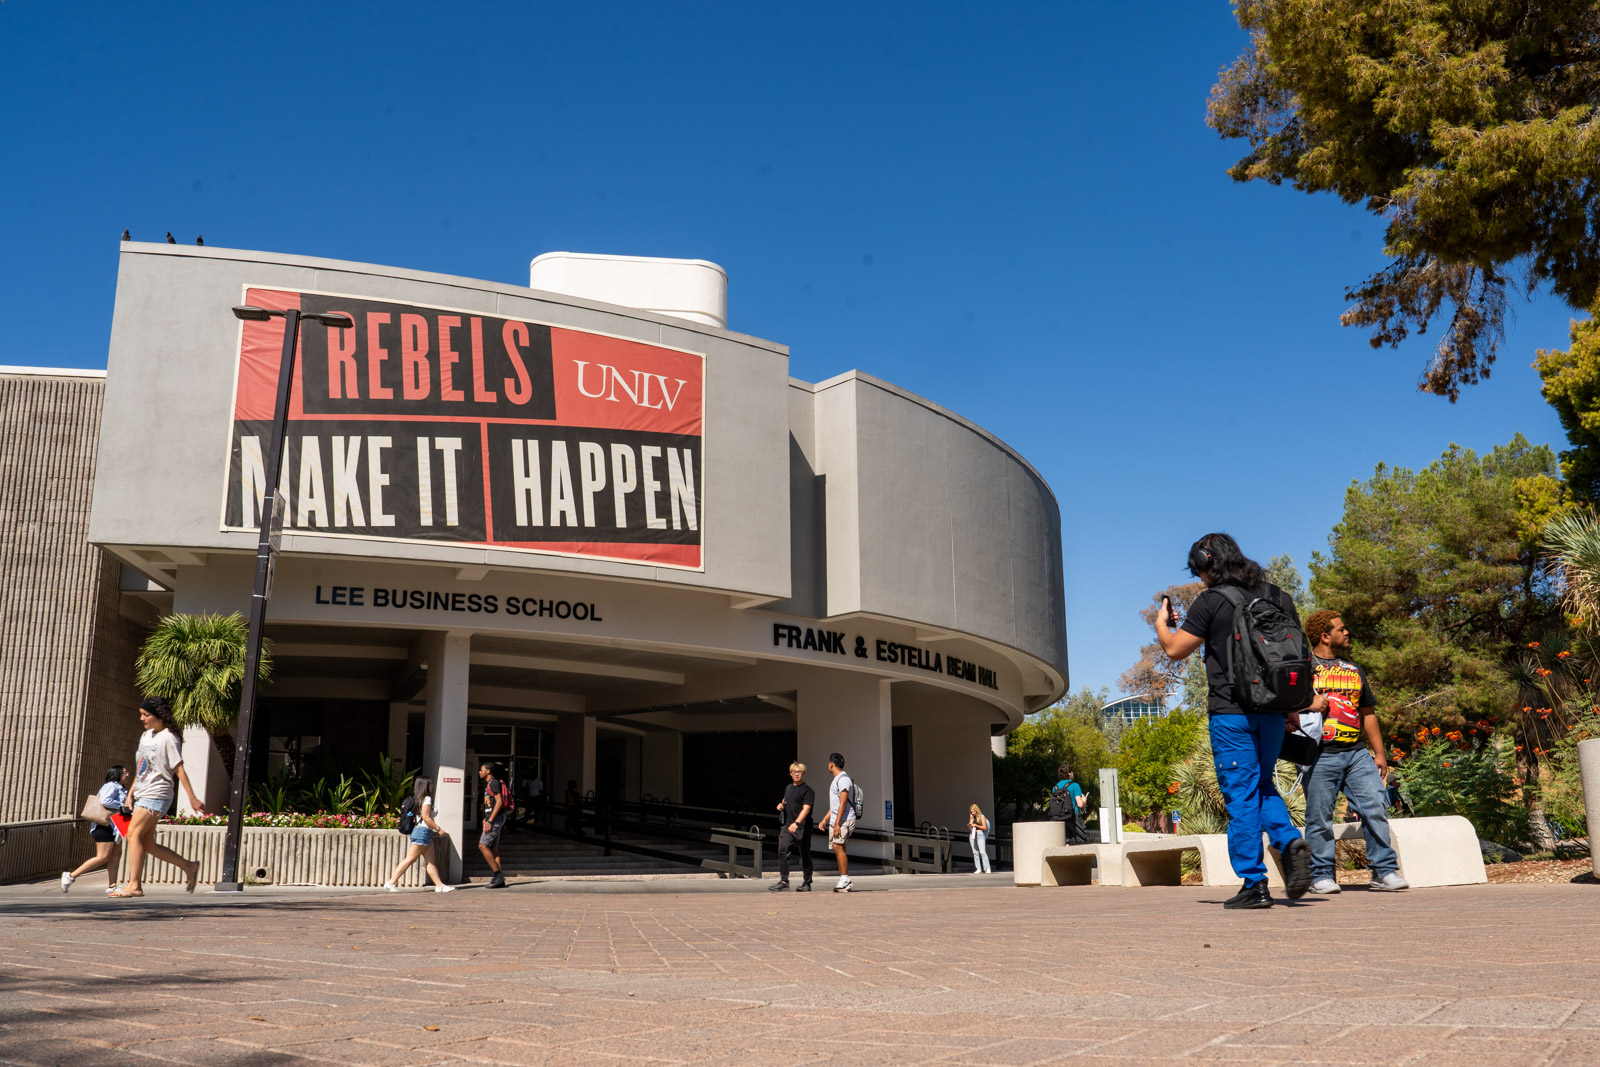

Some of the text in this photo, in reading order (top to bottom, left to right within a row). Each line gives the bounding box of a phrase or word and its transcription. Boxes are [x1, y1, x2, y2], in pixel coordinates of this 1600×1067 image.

[327, 311, 534, 405] REBELS
[572, 359, 687, 412] UNLV
[240, 435, 699, 531] MAKE IT HAPPEN
[315, 585, 603, 622] LEE BUSINESS SCHOOL
[773, 623, 1000, 691] FRANK & ESTELLA BEAM HALL
